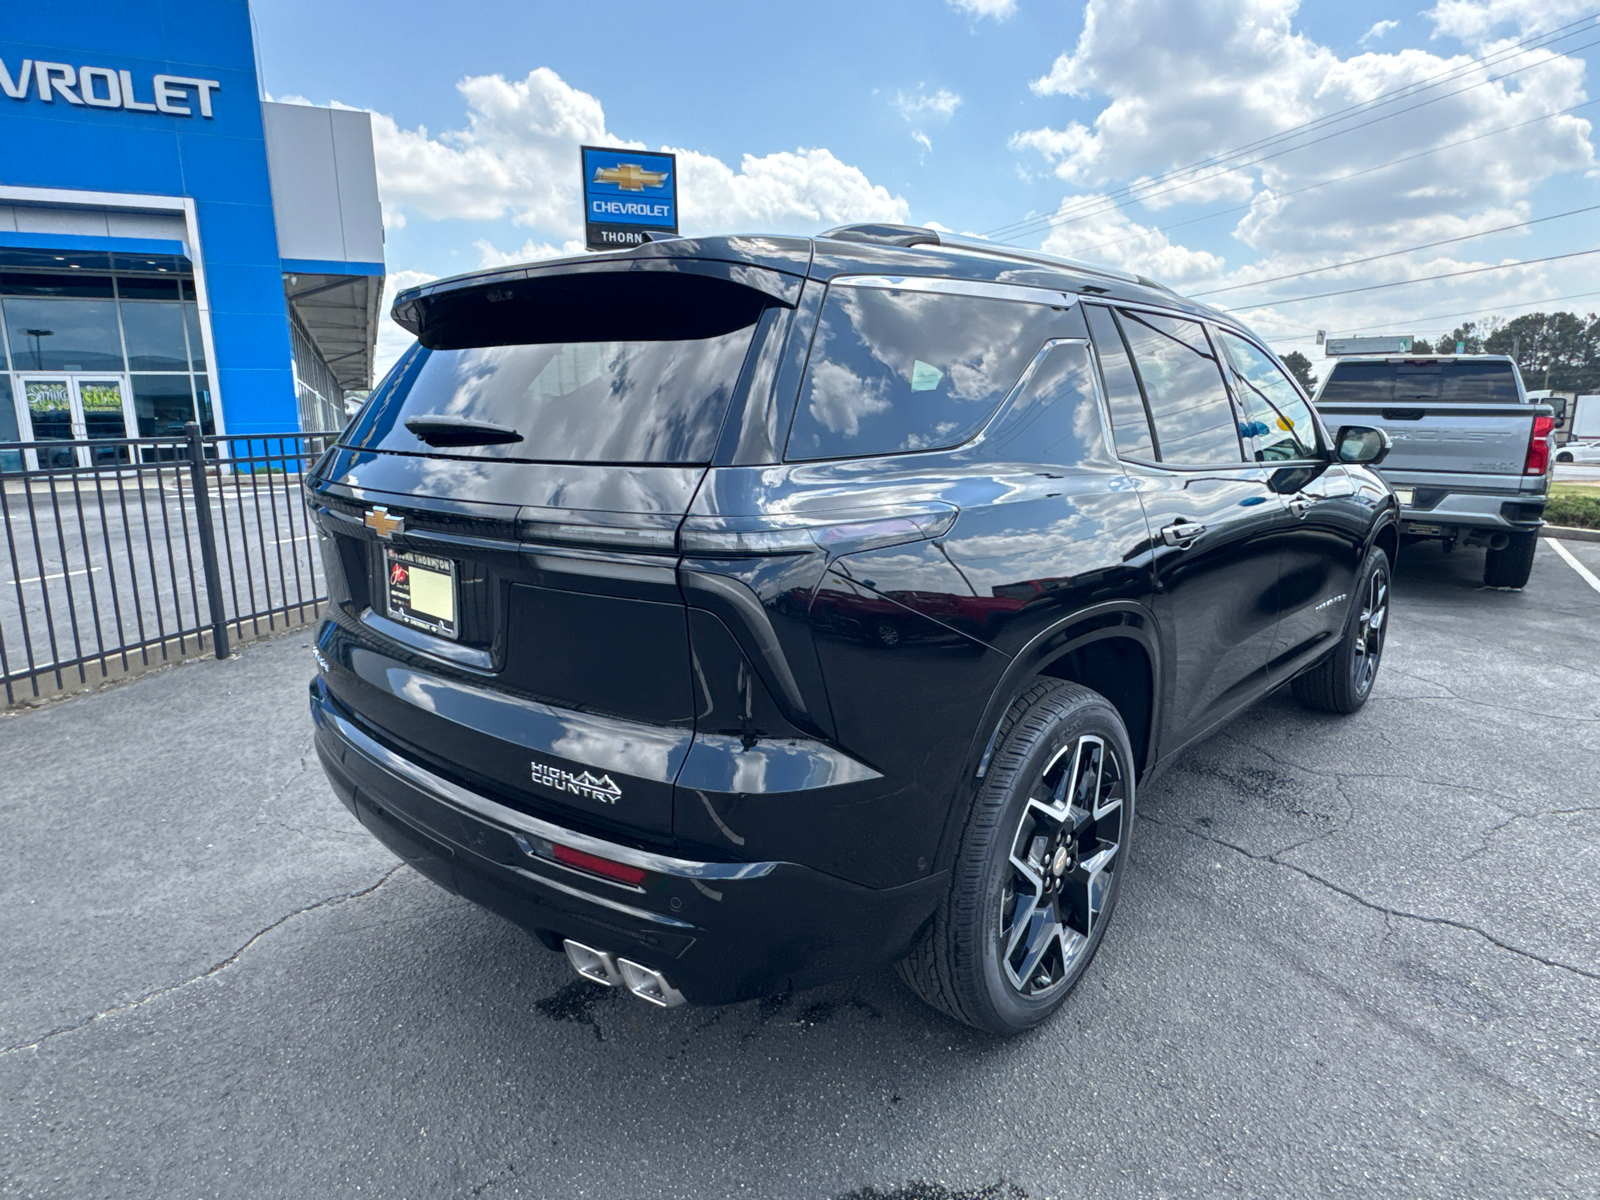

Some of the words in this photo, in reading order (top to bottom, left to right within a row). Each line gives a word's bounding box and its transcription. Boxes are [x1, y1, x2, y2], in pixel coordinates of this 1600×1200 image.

[0, 57, 220, 118] VROLET
[593, 200, 669, 217] CHEVROLET
[601, 231, 643, 244] THORN
[84, 391, 120, 407] SALES
[531, 761, 574, 782] HIGH
[531, 771, 621, 804] COUNTRY
